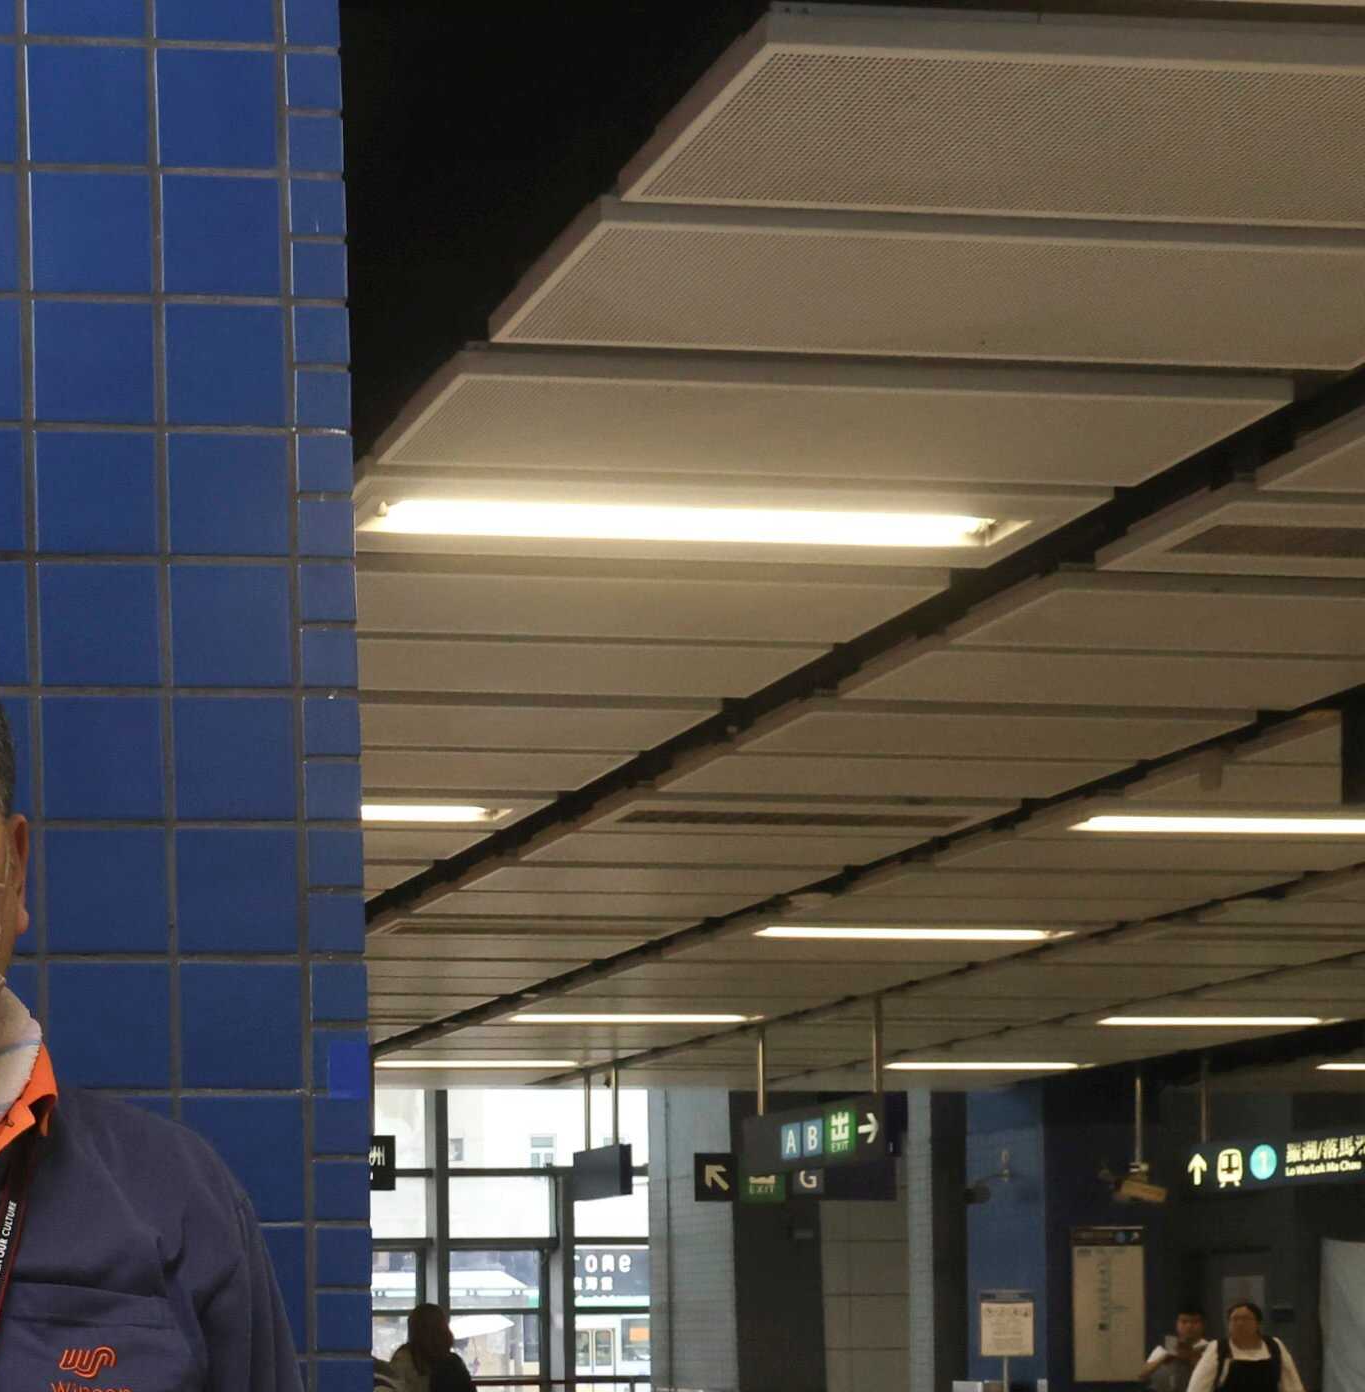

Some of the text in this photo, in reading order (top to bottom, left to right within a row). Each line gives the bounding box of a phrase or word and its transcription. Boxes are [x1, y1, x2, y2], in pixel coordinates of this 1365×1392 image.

[785, 1125, 818, 1155] A B
[831, 1111, 850, 1141] 出
[830, 1140, 850, 1153] EXIT
[1, 1199, 18, 1237] CULTURE
